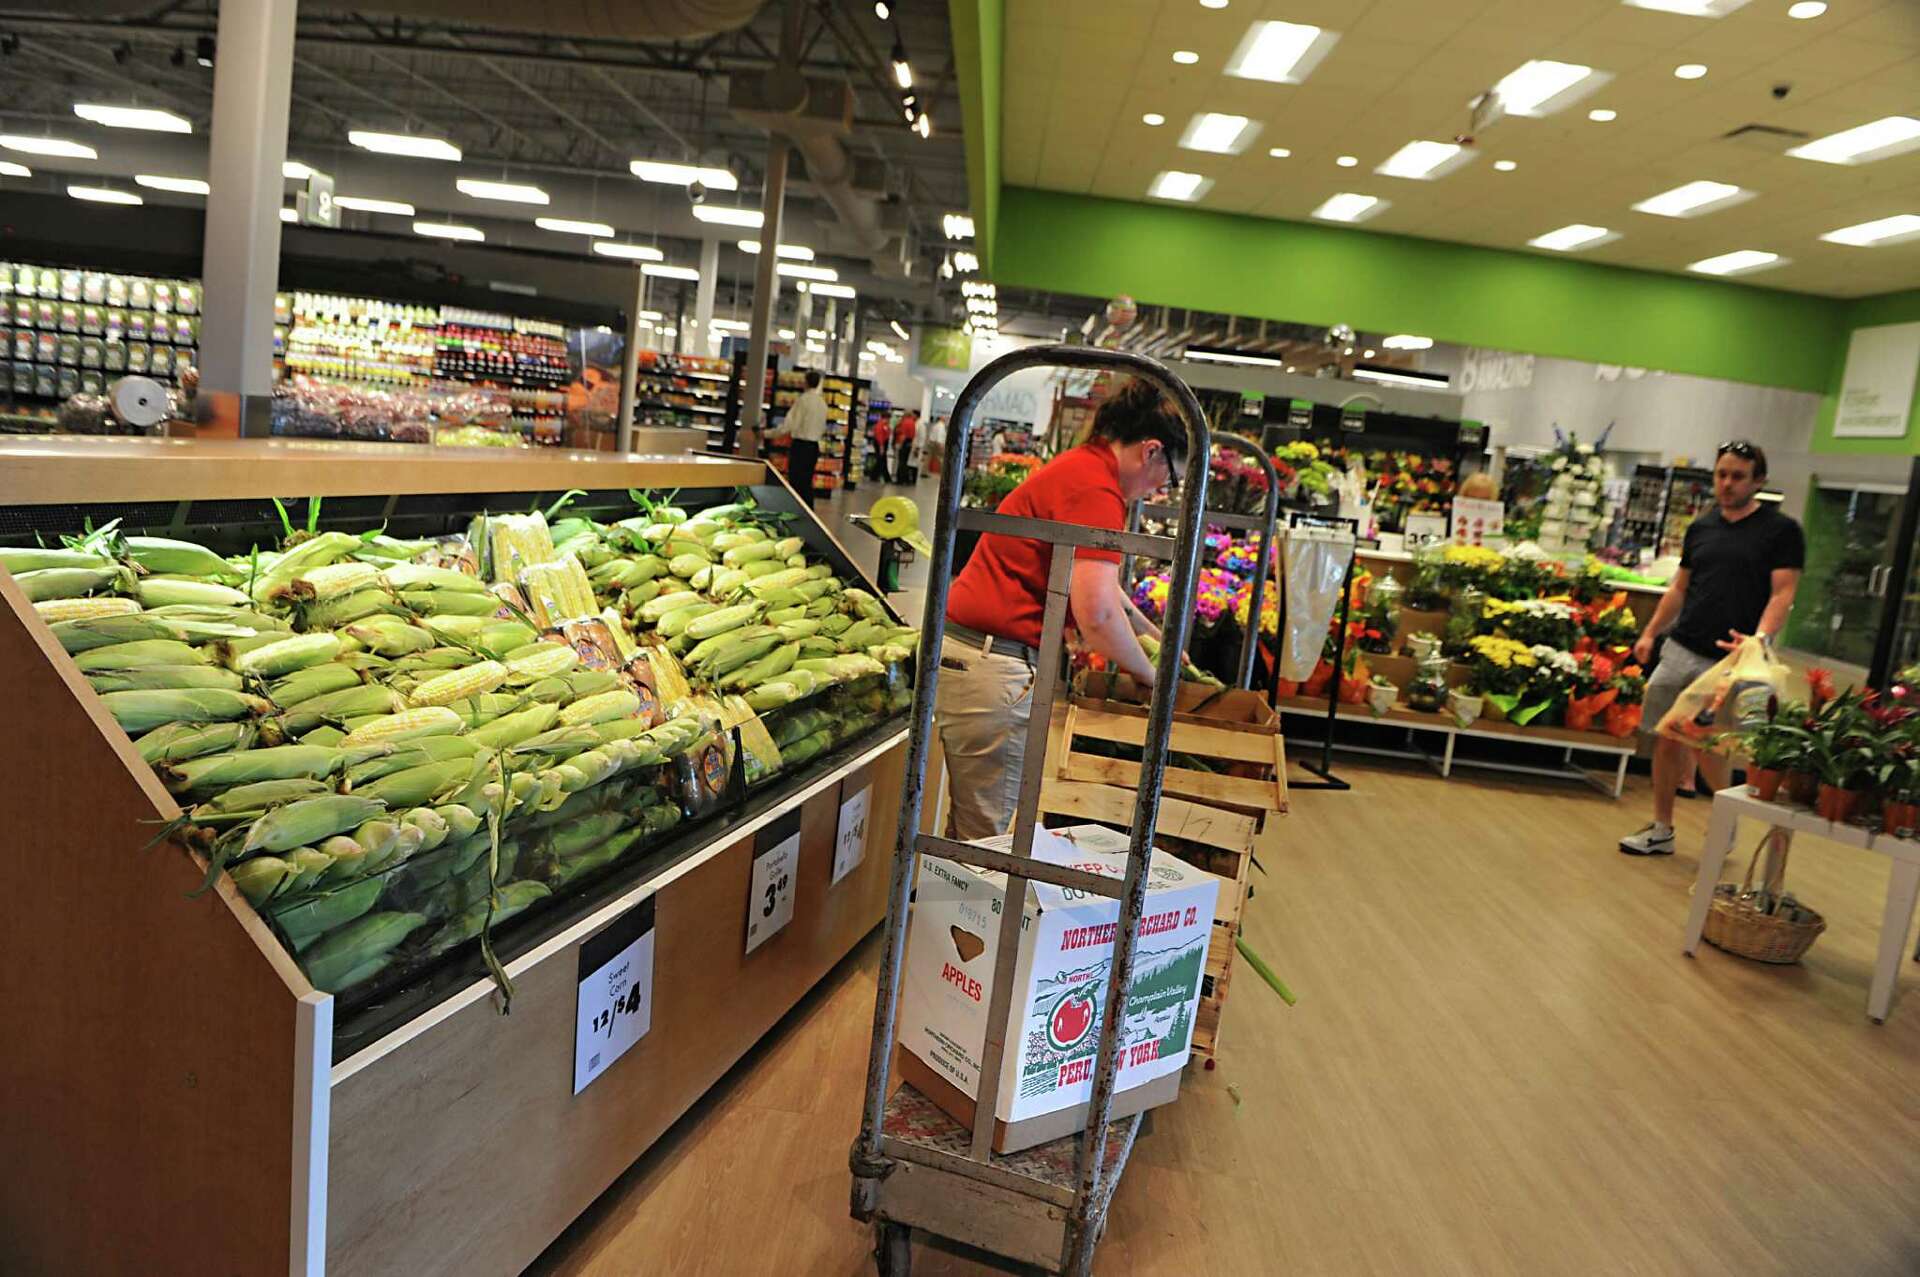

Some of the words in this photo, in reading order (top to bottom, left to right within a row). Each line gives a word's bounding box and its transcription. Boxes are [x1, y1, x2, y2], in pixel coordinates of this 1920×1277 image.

[934, 865, 951, 882] EXTRA
[951, 874, 969, 892] FANCY
[1060, 922, 1118, 951] NORTHER
[1138, 910, 1180, 938] RCHARD
[1183, 906, 1197, 927] CO.
[608, 961, 630, 984] Sweet
[942, 962, 982, 1002] APPLES
[609, 979, 627, 996] Corn
[1128, 991, 1167, 1007] Champlain
[1166, 985, 1187, 999] Valley
[930, 1050, 949, 1069] PRODUCT
[1058, 1059, 1093, 1087] PERU,
[1130, 1039, 1160, 1067] YORK
